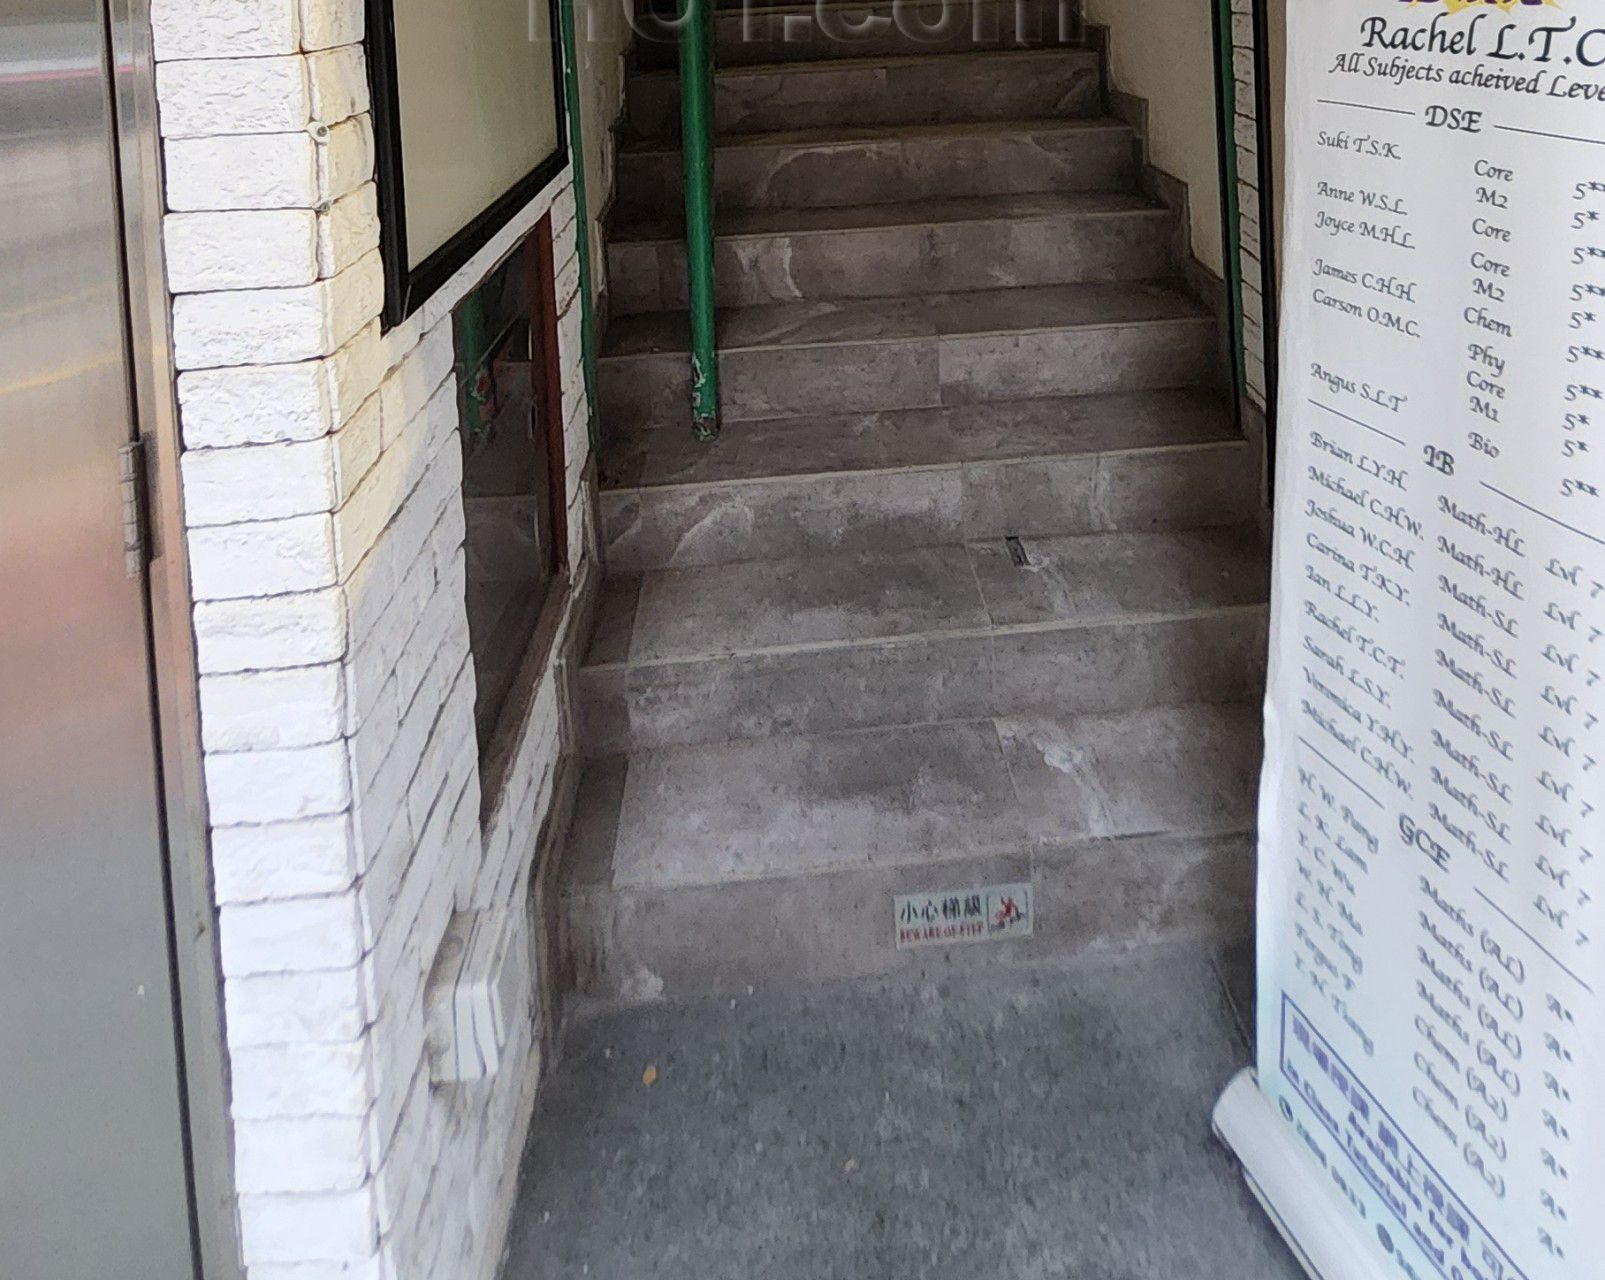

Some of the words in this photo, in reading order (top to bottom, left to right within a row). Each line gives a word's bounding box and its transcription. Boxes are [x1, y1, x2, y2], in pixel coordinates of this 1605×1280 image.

[1360, 11, 1488, 54] Rachel
[1328, 52, 1365, 74] All
[1363, 54, 1444, 86] Subjects
[1448, 63, 1548, 94] acheived
[1425, 105, 1483, 134] DSE
[1317, 130, 1350, 150] Suki
[1474, 159, 1513, 182] Core
[1317, 181, 1355, 202] Anne
[1476, 186, 1510, 209] M2
[1315, 211, 1355, 237] Joyce
[1472, 218, 1512, 243] Core
[1470, 252, 1511, 277] Core
[1312, 288, 1363, 318] Carson
[1472, 278, 1506, 302] M2
[1464, 306, 1512, 338] Chem
[1467, 343, 1506, 377] Phy
[1310, 362, 1357, 394] Angus
[1466, 370, 1506, 399] Core
[1310, 431, 1354, 464] Brian
[1467, 431, 1500, 459] Bio
[1423, 445, 1455, 476] IB
[1308, 465, 1365, 509] Michael
[1304, 498, 1356, 538] Joshua
[1399, 812, 1451, 873] GCE
